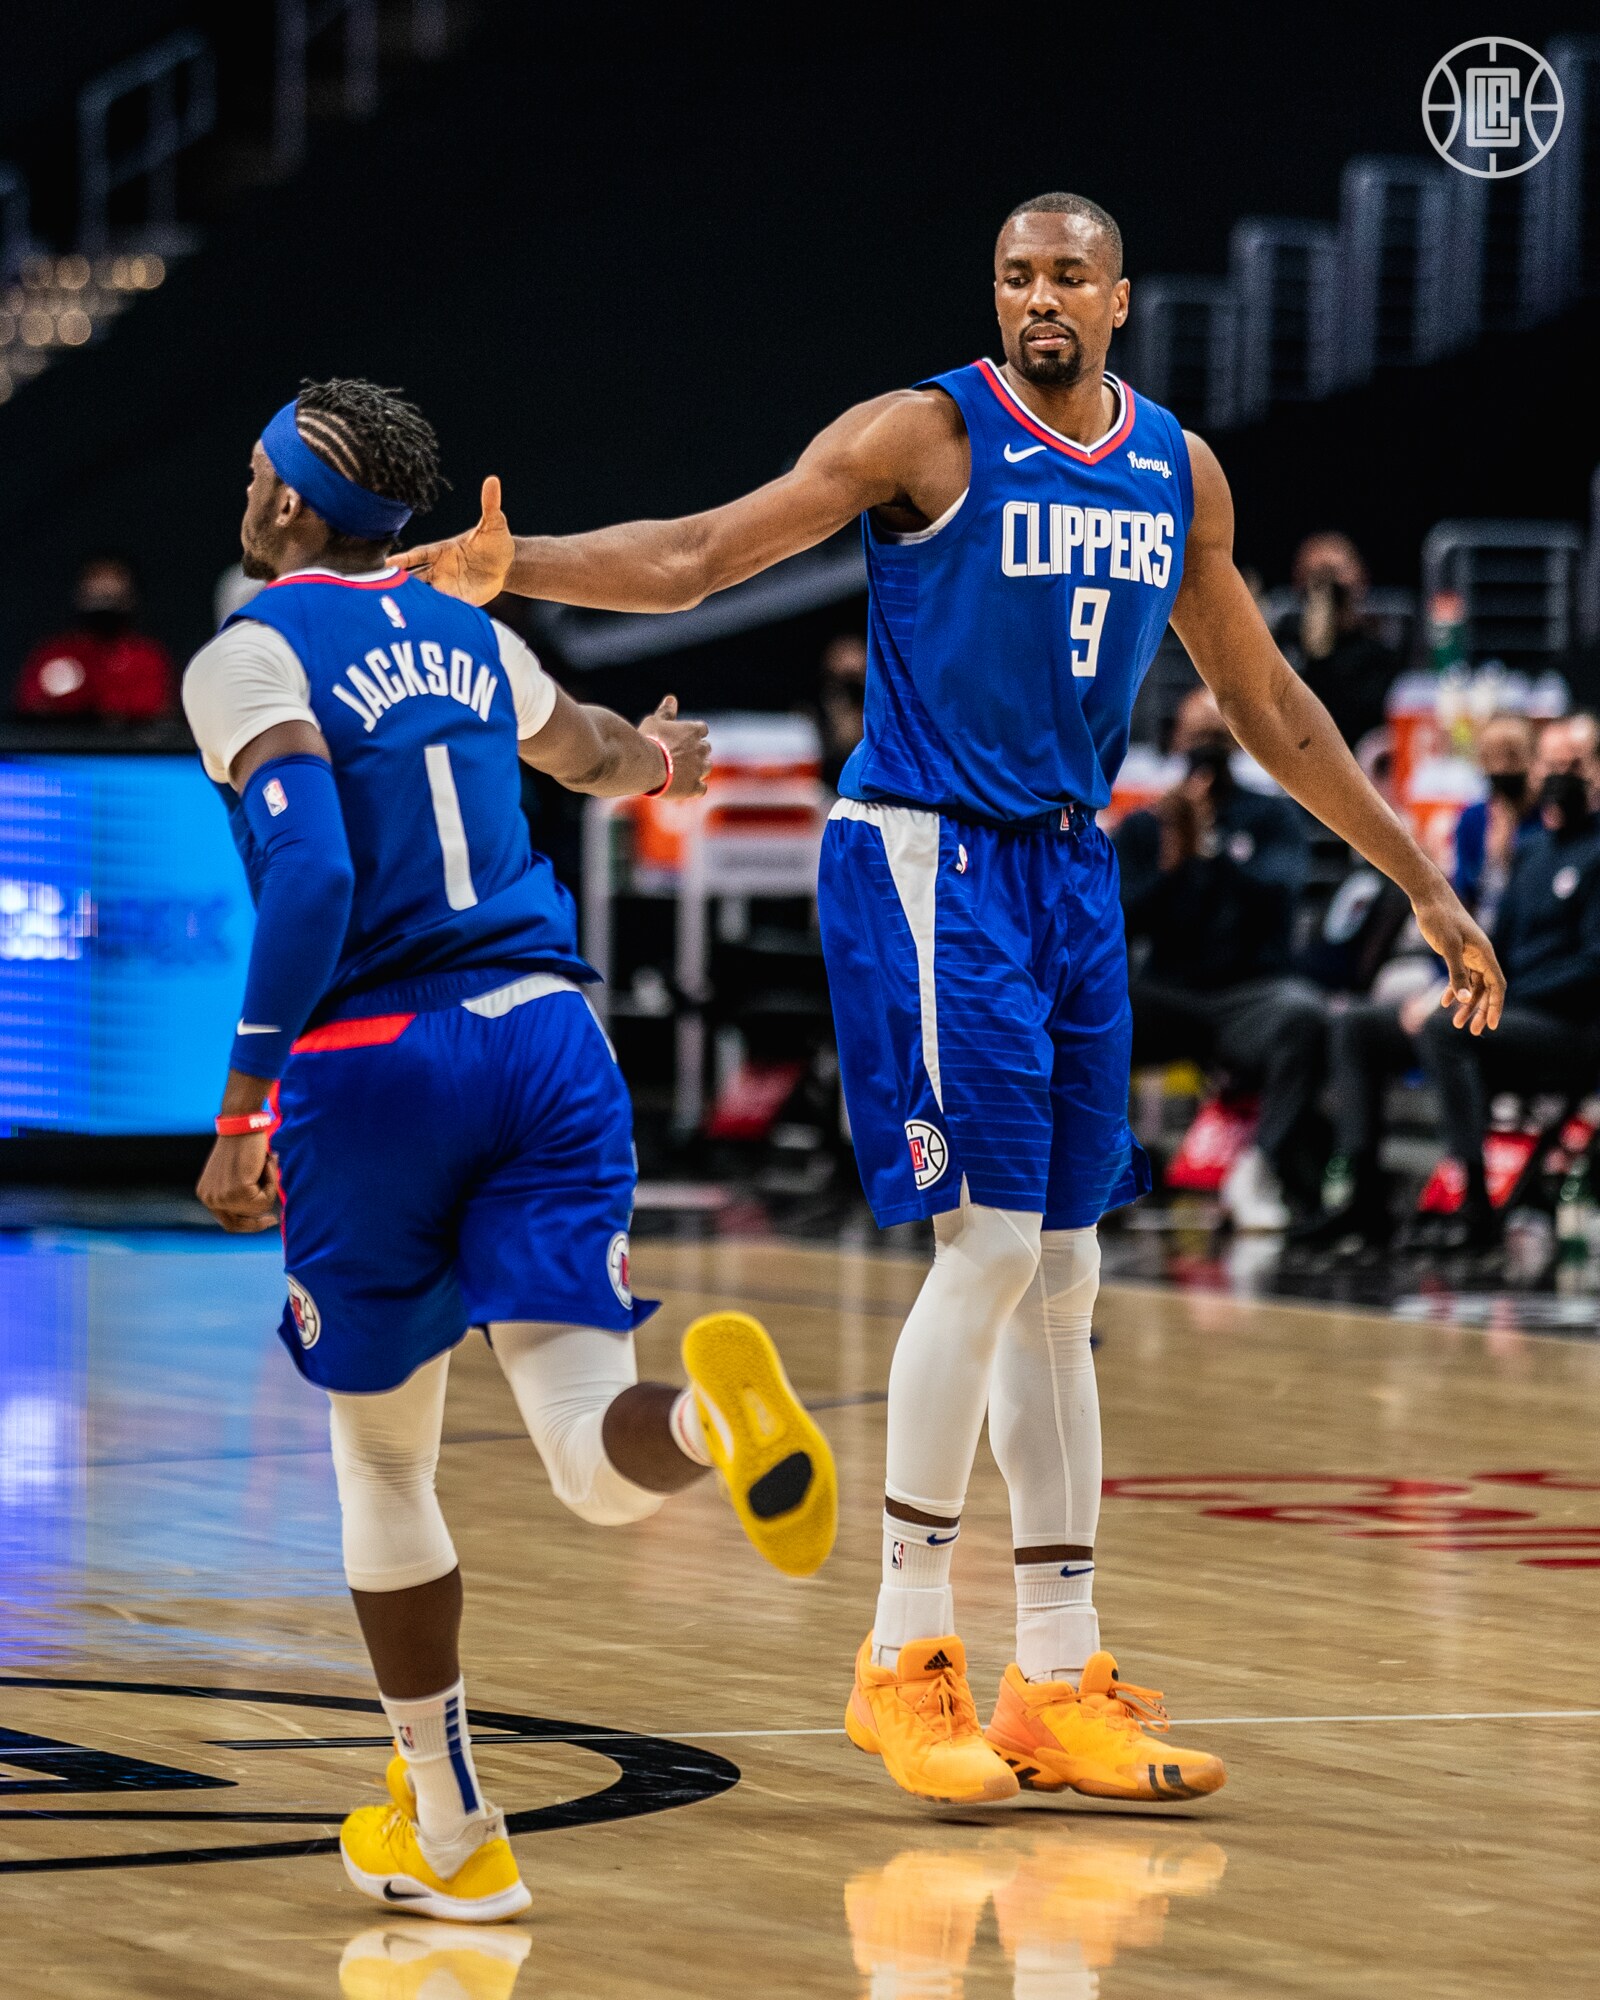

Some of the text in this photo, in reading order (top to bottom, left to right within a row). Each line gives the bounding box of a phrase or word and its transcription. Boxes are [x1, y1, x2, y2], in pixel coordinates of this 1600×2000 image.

[1127, 451, 1172, 479] honey
[1002, 501, 1174, 589] CLIPPERS
[1070, 587, 1111, 677] 9
[332, 640, 498, 733] JACKSON
[424, 743, 478, 911] 1
